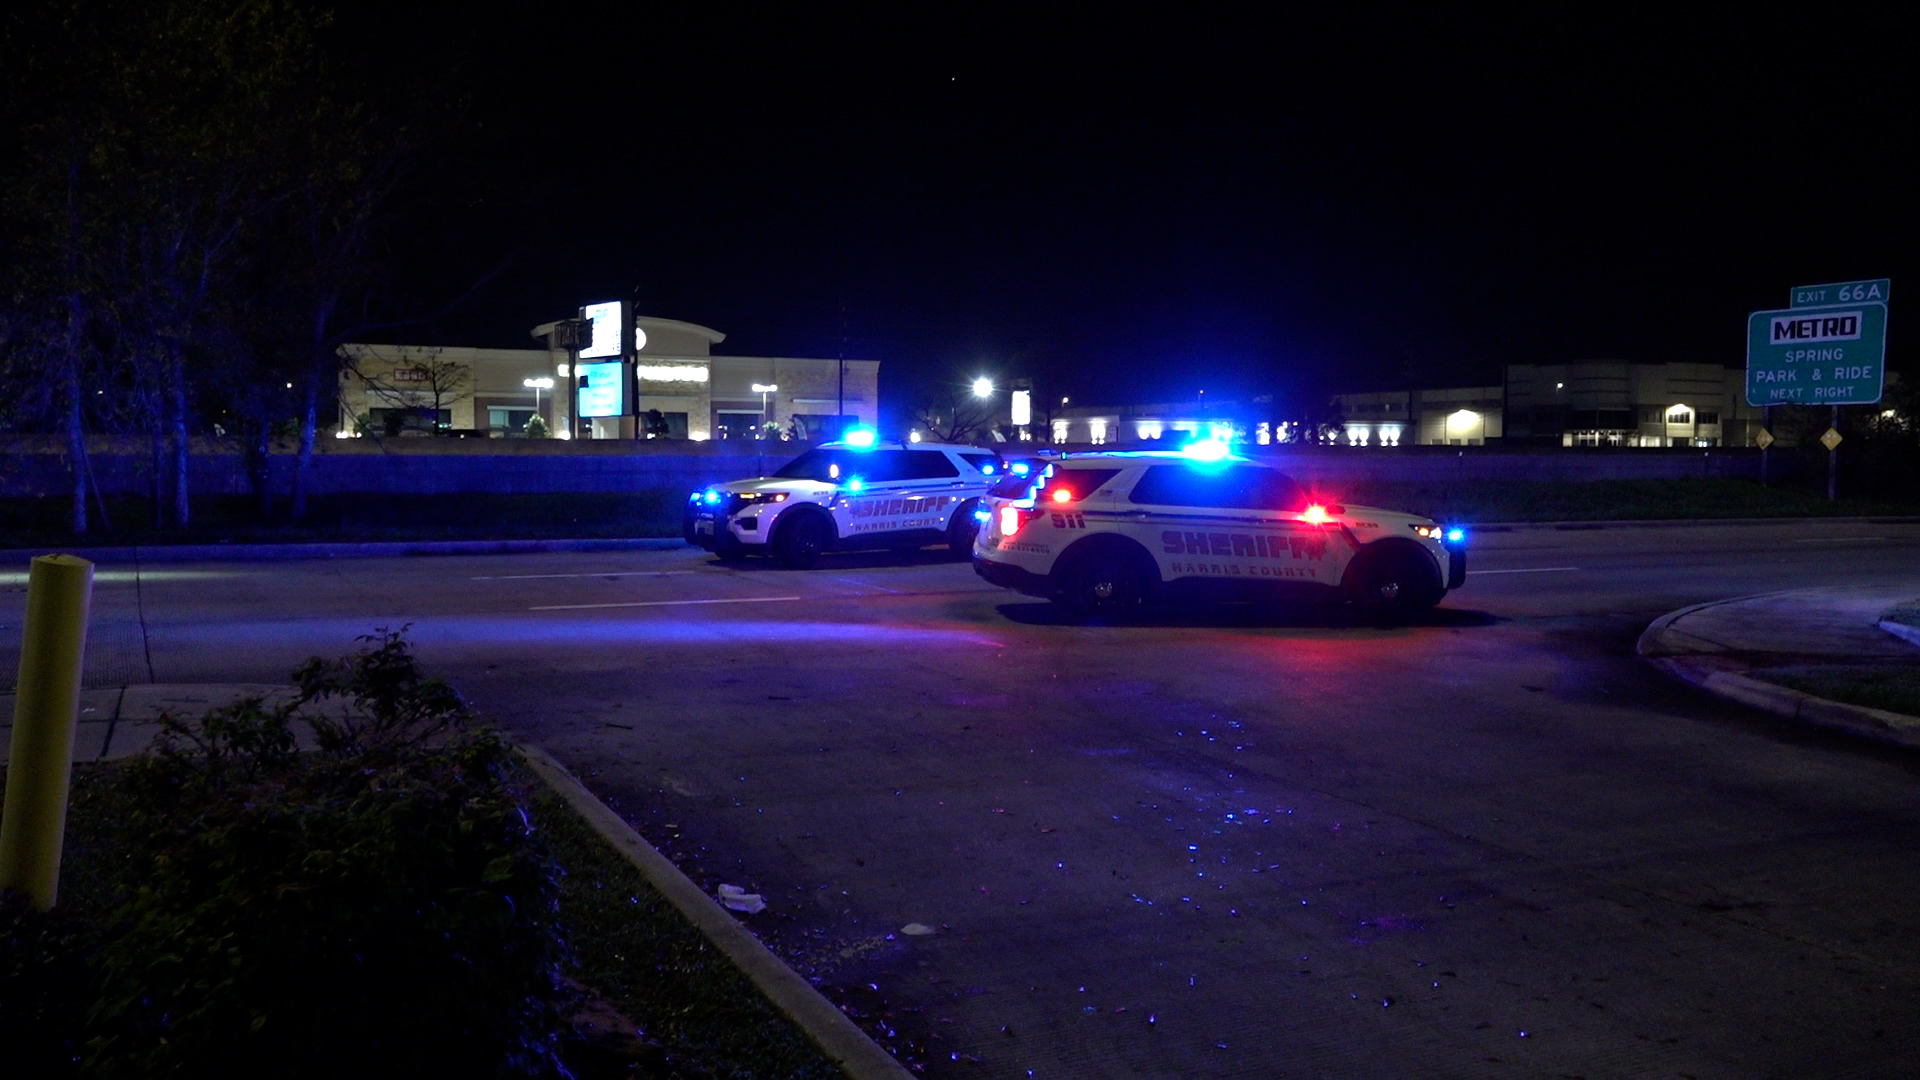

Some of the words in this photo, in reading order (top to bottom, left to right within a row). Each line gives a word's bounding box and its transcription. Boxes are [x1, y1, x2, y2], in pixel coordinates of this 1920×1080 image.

[1797, 289, 1827, 303] EXIT
[1838, 283, 1882, 302] 66A
[1774, 316, 1857, 340] METRO
[1785, 348, 1844, 363] SPRING
[1756, 369, 1797, 383] PARK
[1811, 368, 1823, 381] &
[1835, 365, 1873, 380] RIDE
[1770, 387, 1804, 399] NEXT
[1814, 385, 1855, 398] RIGHT
[858, 496, 950, 518] SHERIFF
[855, 521, 897, 532] HARRIS
[1051, 513, 1086, 528] 911
[1161, 531, 1312, 560] SHERIFF
[1173, 563, 1240, 575] HARRIS
[1248, 565, 1316, 577] COUNTY
